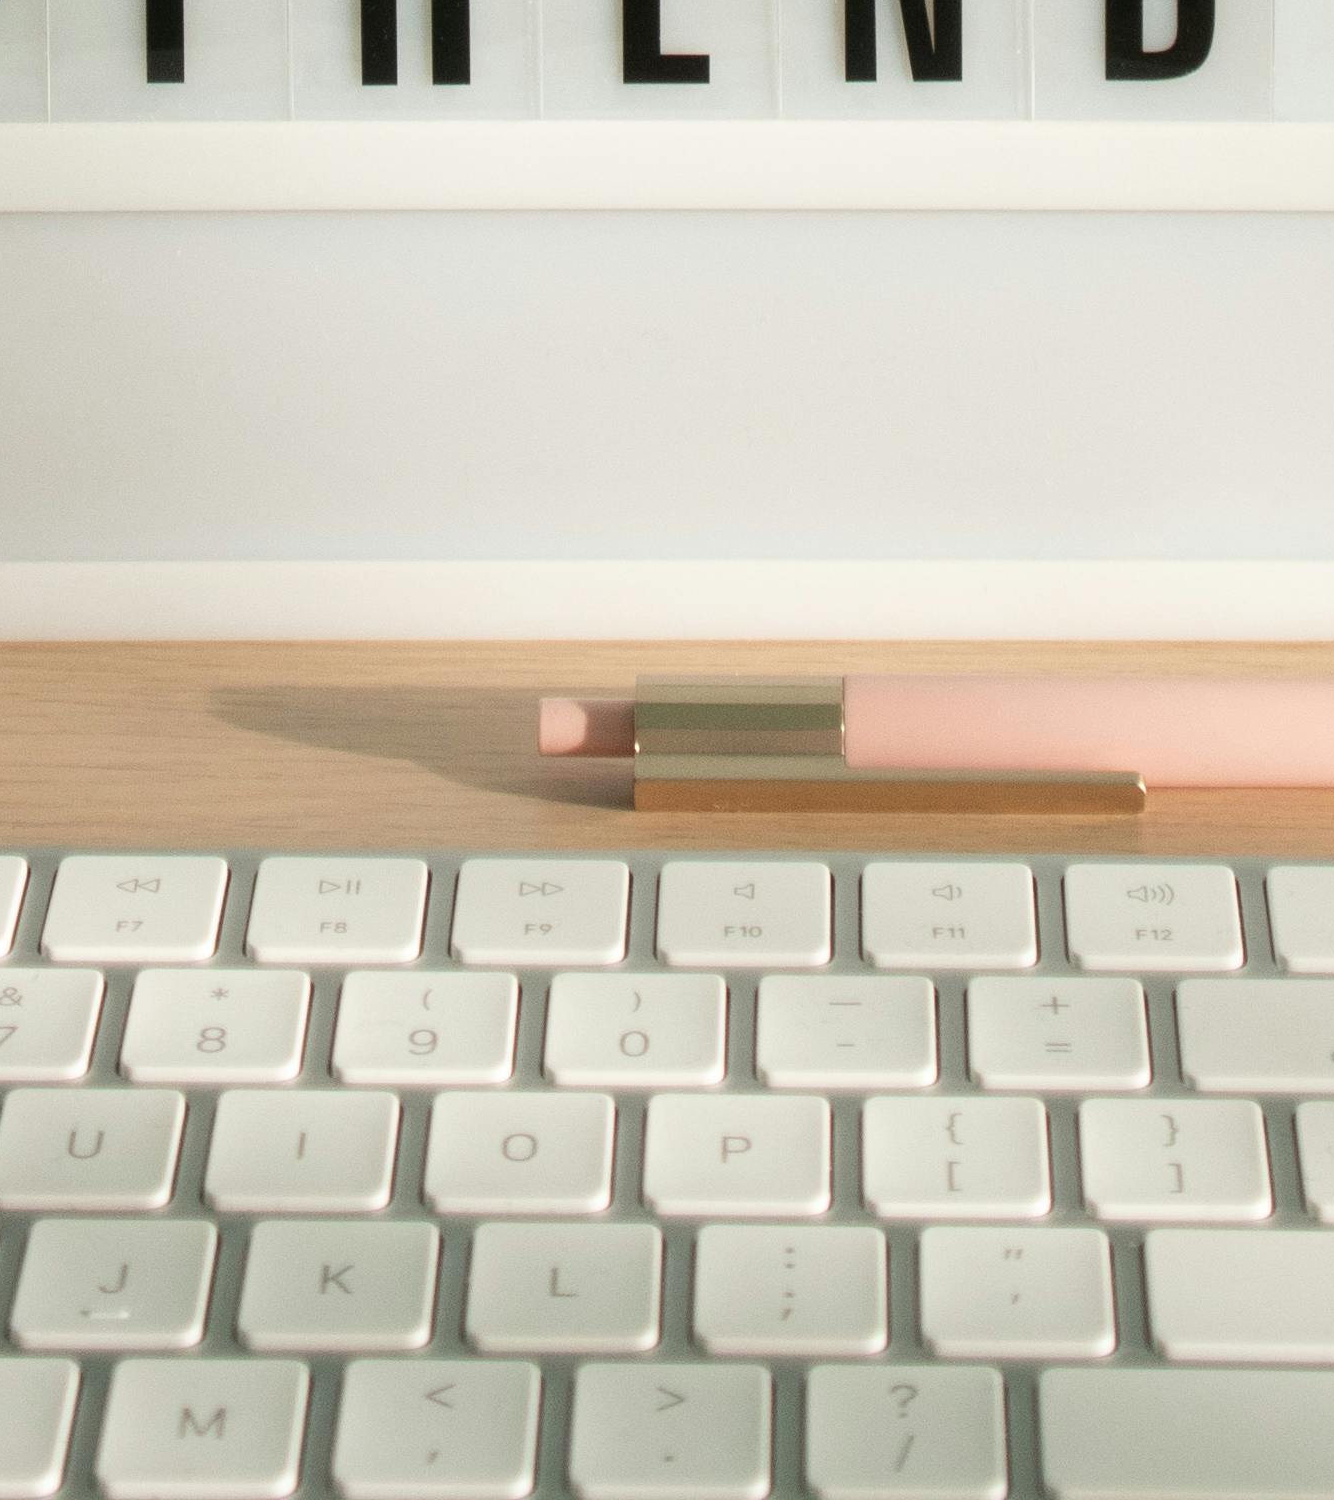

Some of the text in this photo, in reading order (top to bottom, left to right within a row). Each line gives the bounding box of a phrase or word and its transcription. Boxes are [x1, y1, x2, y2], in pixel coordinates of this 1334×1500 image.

[722, 924, 764, 938] F10
[931, 926, 966, 939] F11
[1134, 928, 1173, 942] F12
[195, 1026, 227, 1054] 8
[408, 1028, 439, 1056] 9
[618, 1030, 651, 1057] 0
[66, 1130, 105, 1160] U
[500, 1132, 539, 1163] O
[720, 1135, 753, 1164] P
